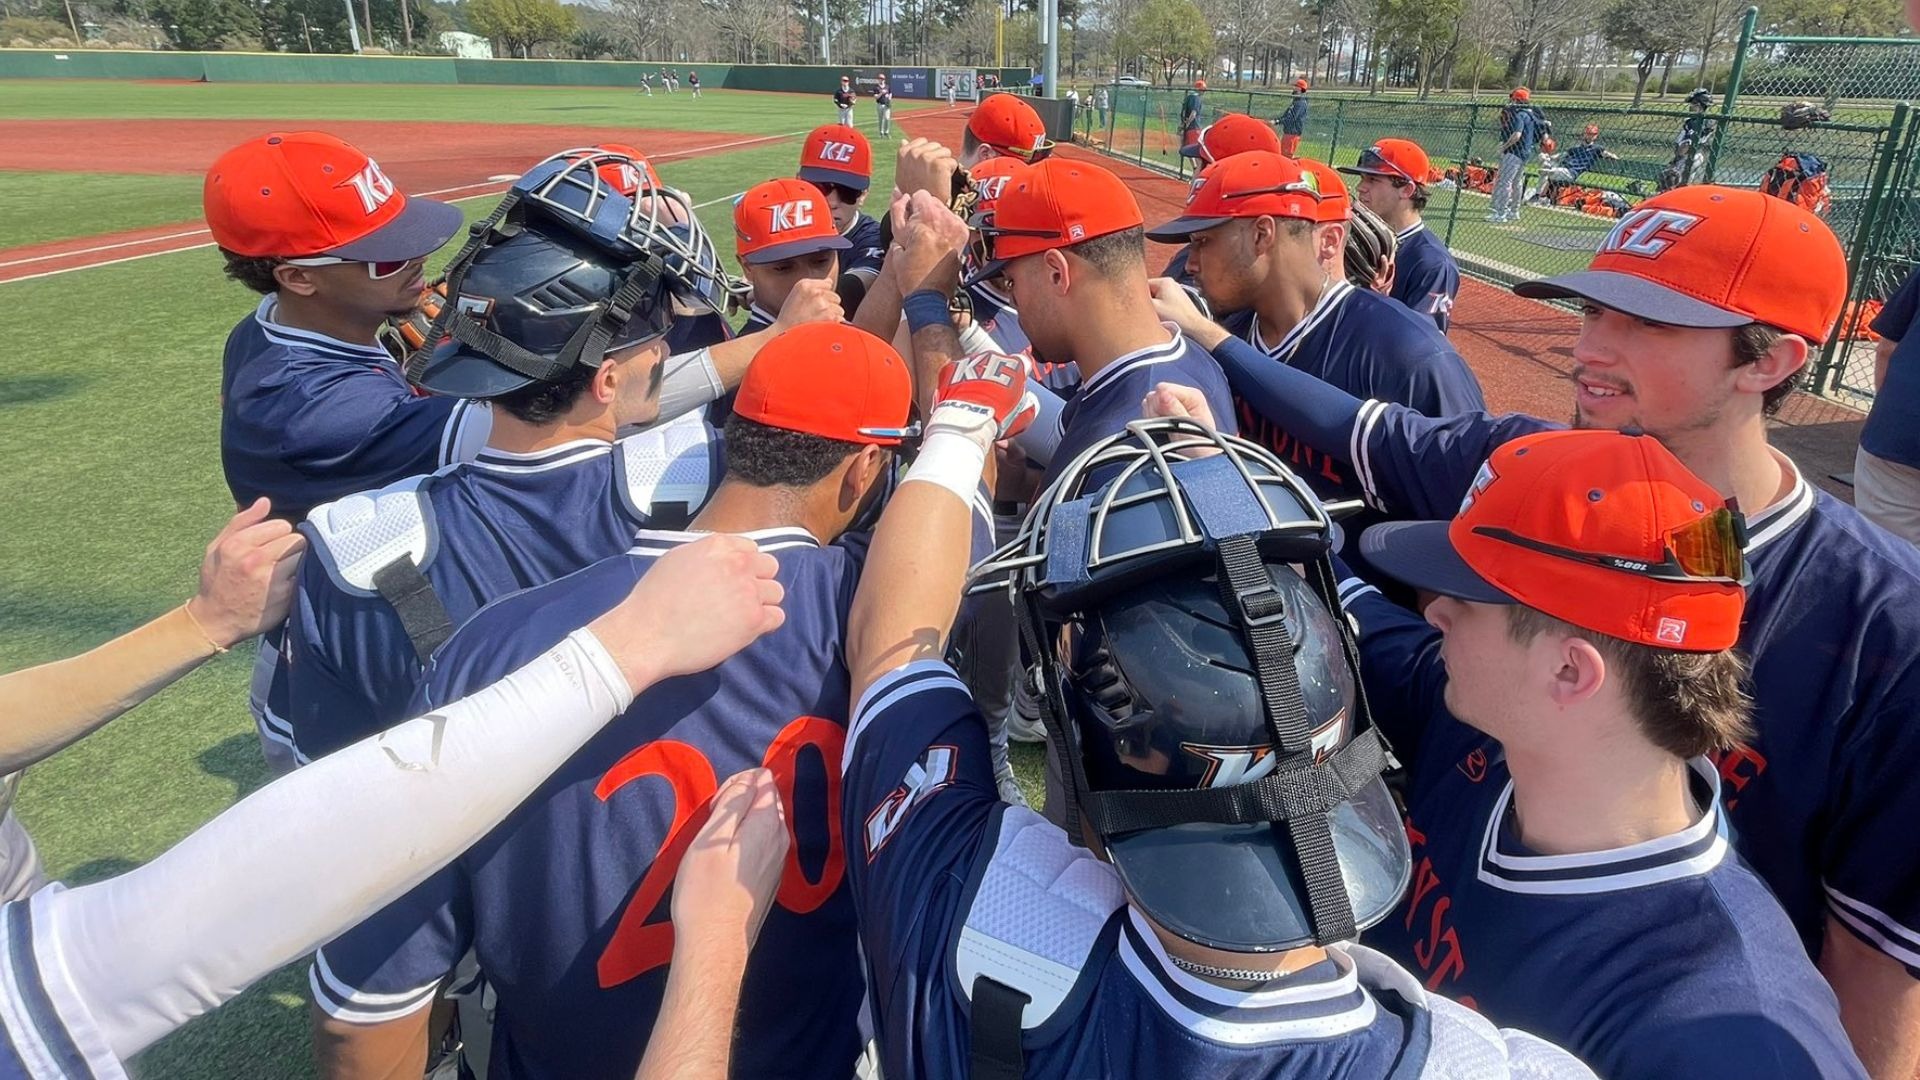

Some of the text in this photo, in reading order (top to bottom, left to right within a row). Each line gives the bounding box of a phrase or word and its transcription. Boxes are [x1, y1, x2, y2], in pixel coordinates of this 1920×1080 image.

[819, 140, 856, 163] KC
[767, 199, 814, 234] KC
[949, 352, 1020, 388] KC
[1613, 559, 1648, 571] 100%
[593, 714, 847, 988] 20
